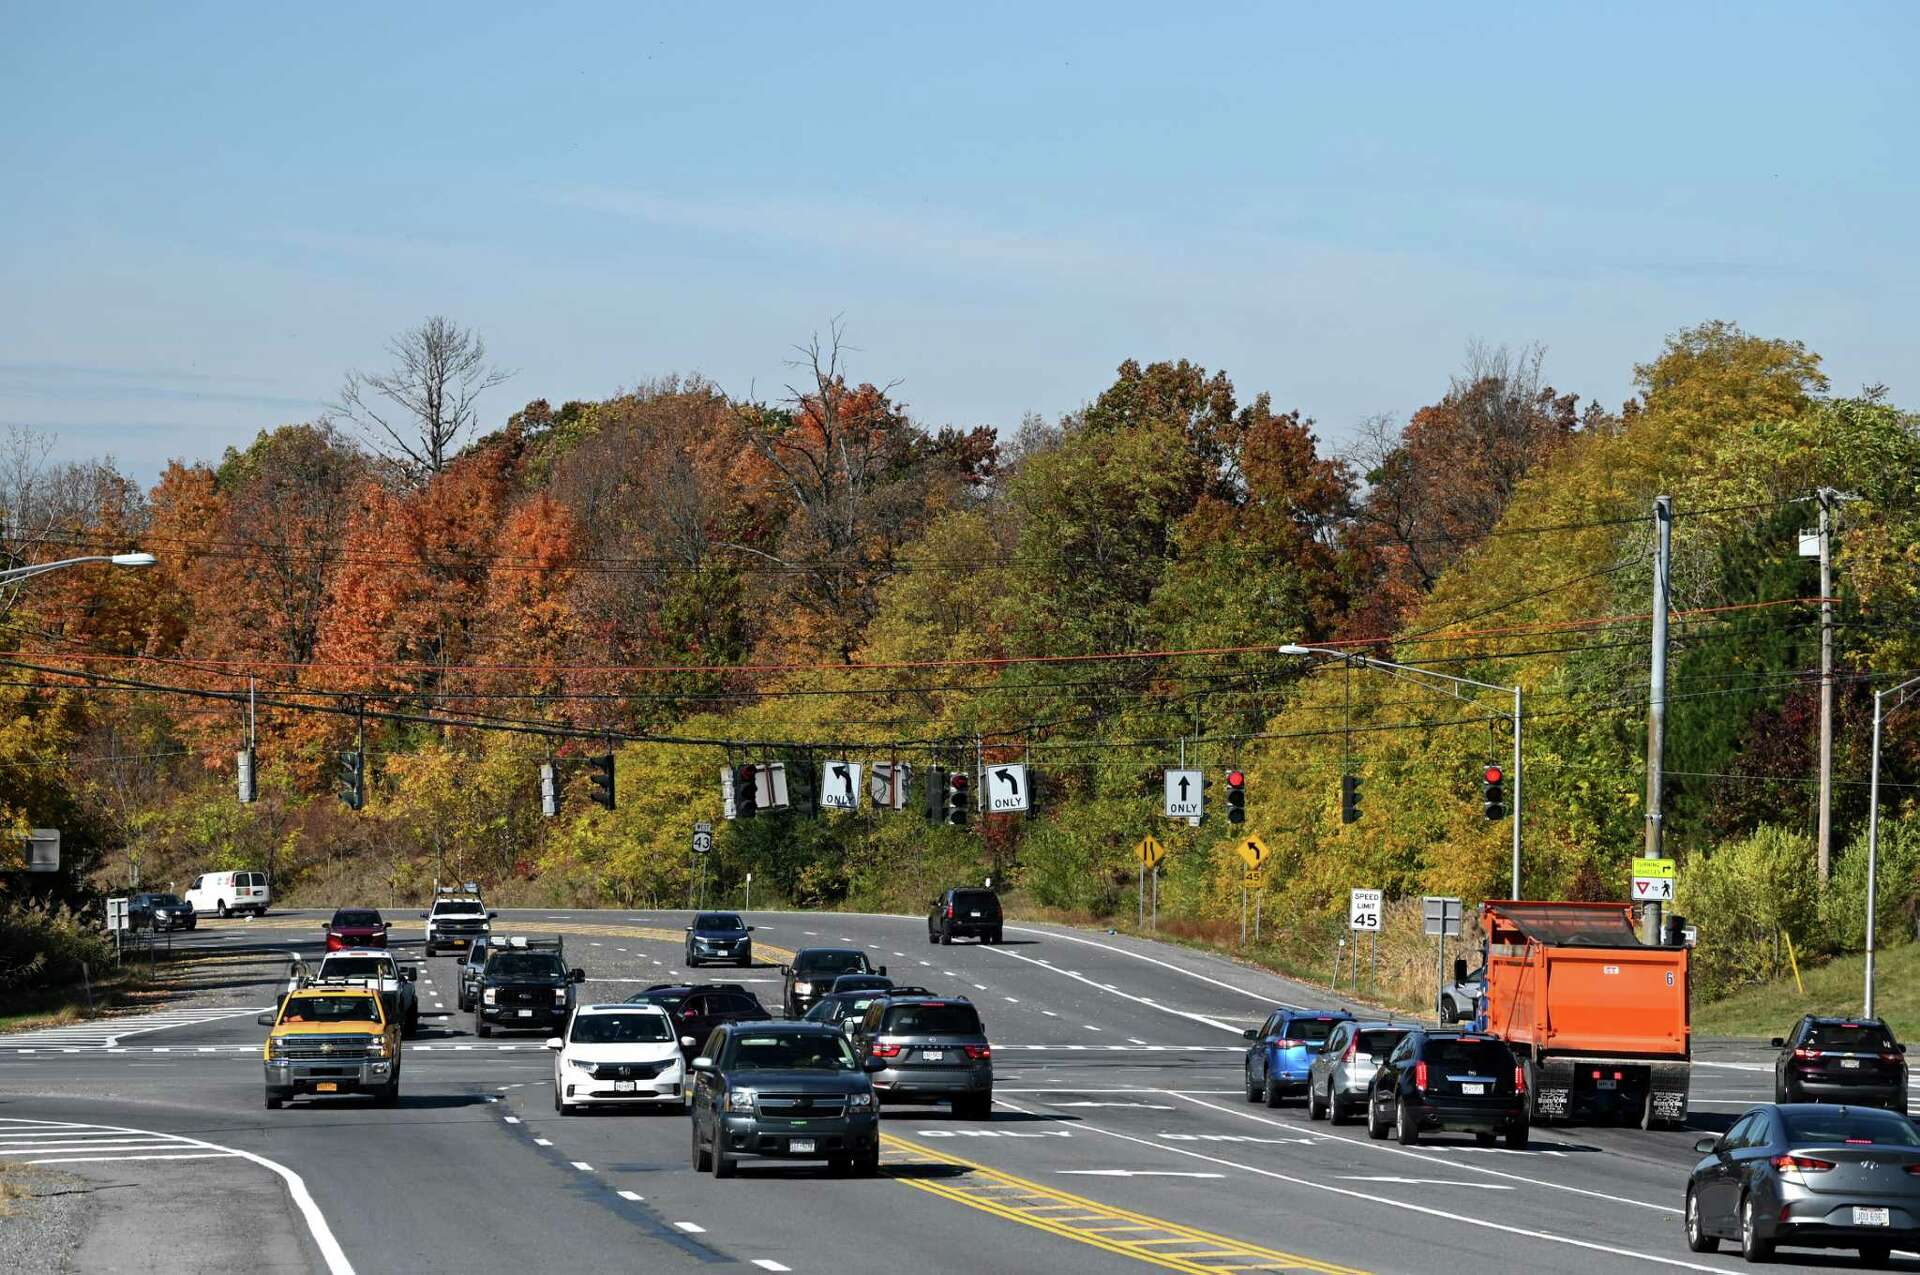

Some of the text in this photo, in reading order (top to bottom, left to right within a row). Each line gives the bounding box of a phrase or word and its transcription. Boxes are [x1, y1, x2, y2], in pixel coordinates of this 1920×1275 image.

[995, 797, 1021, 808] ONLY
[1170, 803, 1197, 813] ONLY
[694, 836, 710, 849] 43
[1246, 872, 1260, 881] 45
[1354, 892, 1379, 901] SPEED
[1357, 902, 1375, 910] LIMIT
[1353, 913, 1377, 927] 45
[1665, 971, 1674, 986] 6
